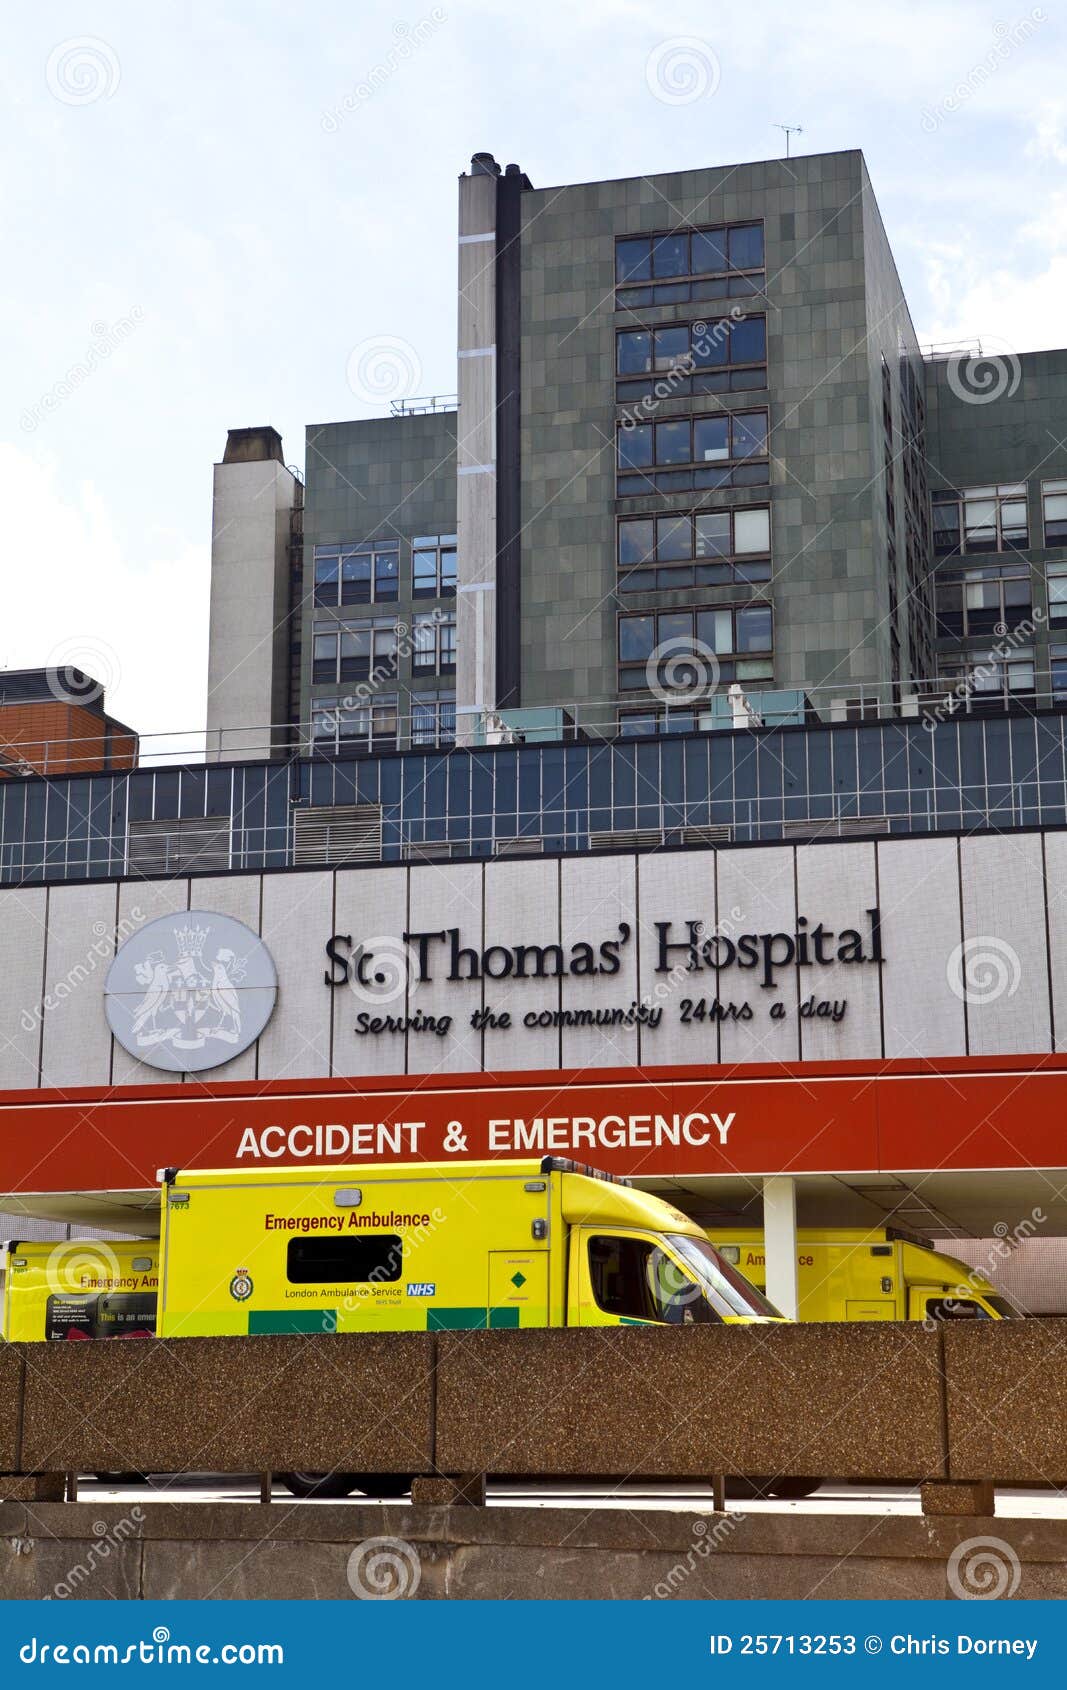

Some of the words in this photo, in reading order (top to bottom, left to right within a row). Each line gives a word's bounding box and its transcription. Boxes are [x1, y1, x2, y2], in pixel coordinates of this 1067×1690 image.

[324, 934, 386, 986] St.
[403, 922, 631, 983] Thomas'
[654, 908, 886, 988] Hospital
[355, 1009, 453, 1036] Serving
[470, 1006, 512, 1030] the
[523, 1001, 663, 1029] community
[679, 998, 753, 1023] 24hrs
[769, 1001, 786, 1020] a
[800, 995, 847, 1022] day
[236, 1121, 426, 1158] ACCIDENT
[442, 1120, 469, 1153] &
[488, 1112, 736, 1151] EMERGENCY
[265, 1213, 344, 1233] Emergency
[348, 1211, 430, 1229] Ambulance
[80, 1276, 139, 1291] Emergency
[285, 1289, 318, 1298] London
[320, 1288, 370, 1298] Ambulance
[371, 1287, 402, 1297] Service
[407, 1283, 435, 1296] NHS
[100, 1312, 116, 1321] This
[117, 1312, 124, 1321] is
[125, 1313, 135, 1321] an
